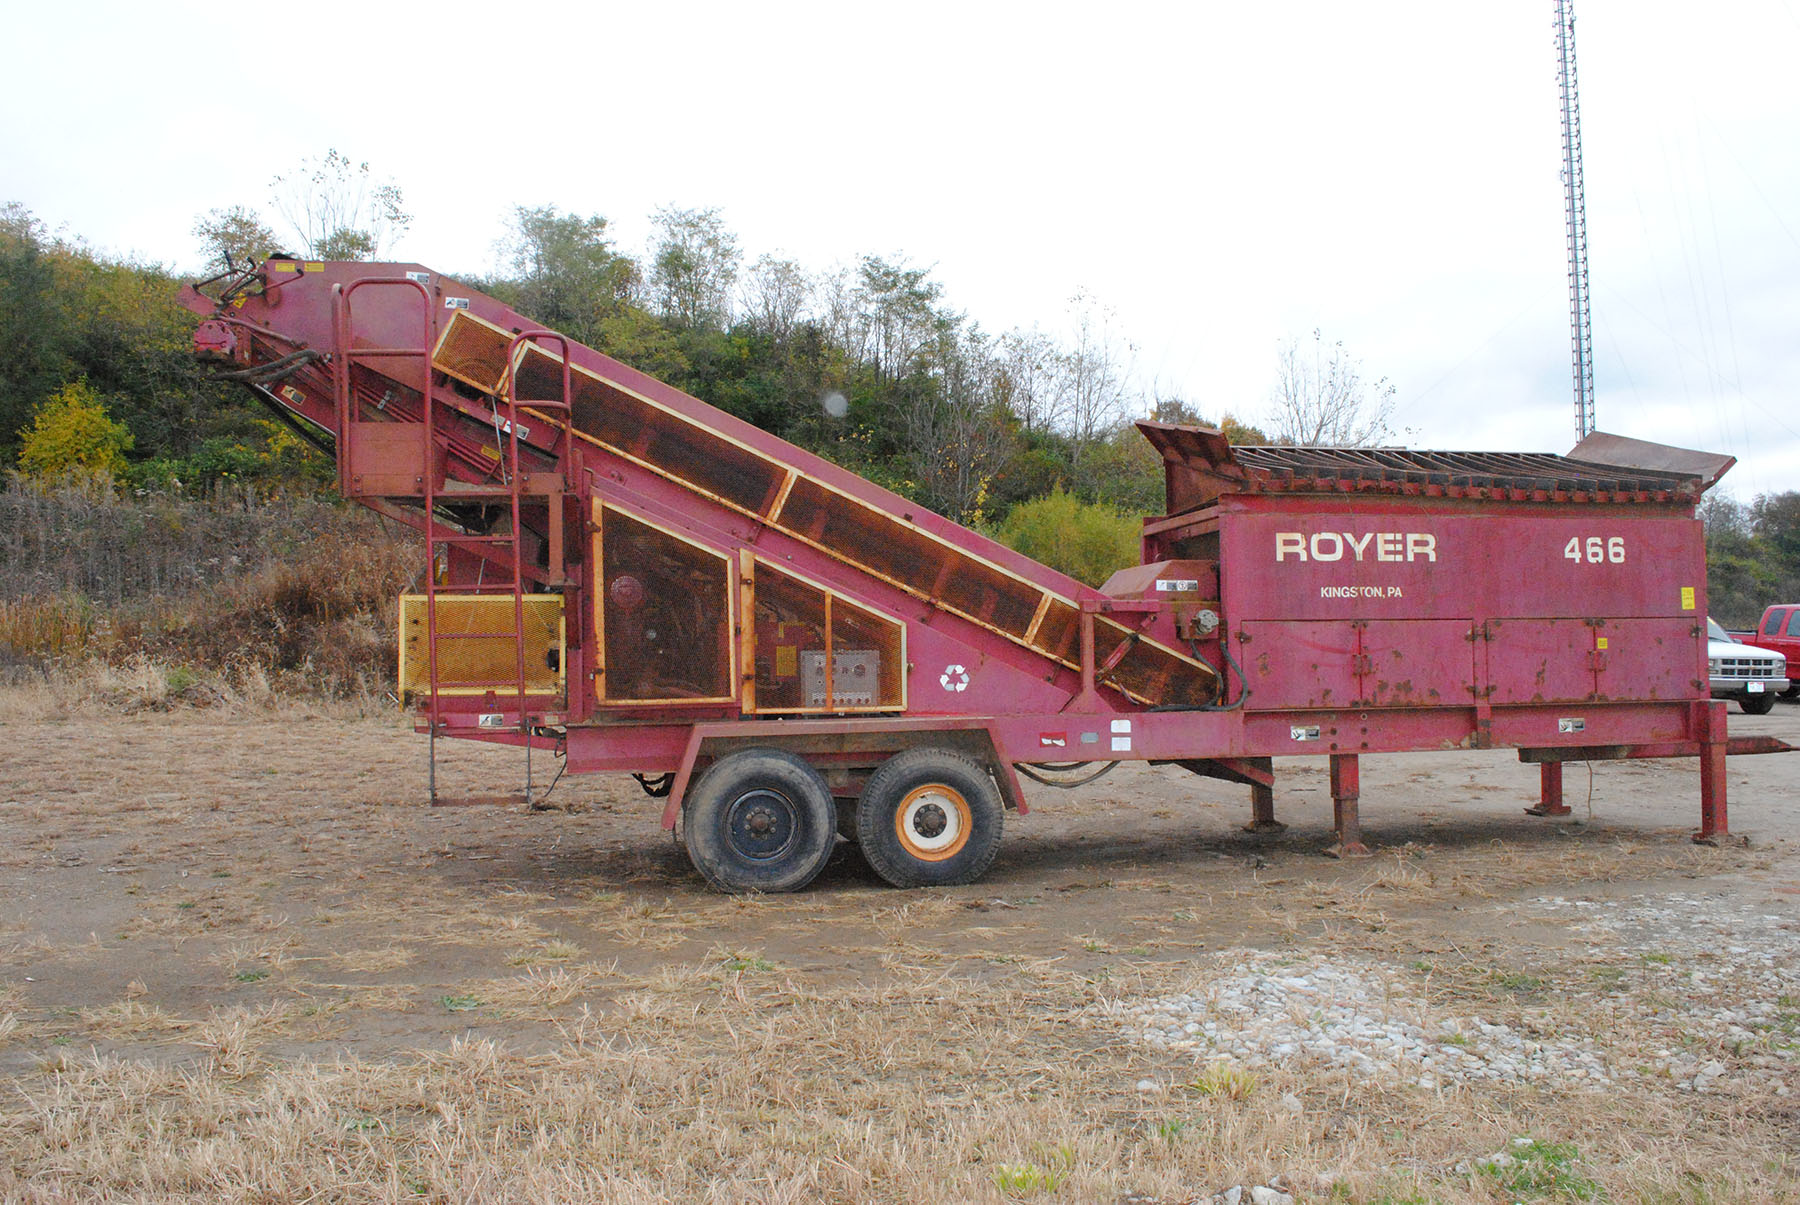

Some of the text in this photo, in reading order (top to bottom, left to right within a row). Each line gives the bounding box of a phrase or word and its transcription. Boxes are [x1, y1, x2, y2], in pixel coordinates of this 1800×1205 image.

[1275, 532, 1437, 562] ROYER
[1564, 536, 1625, 563] 466
[1320, 586, 1403, 599] KINGSTON, PA
